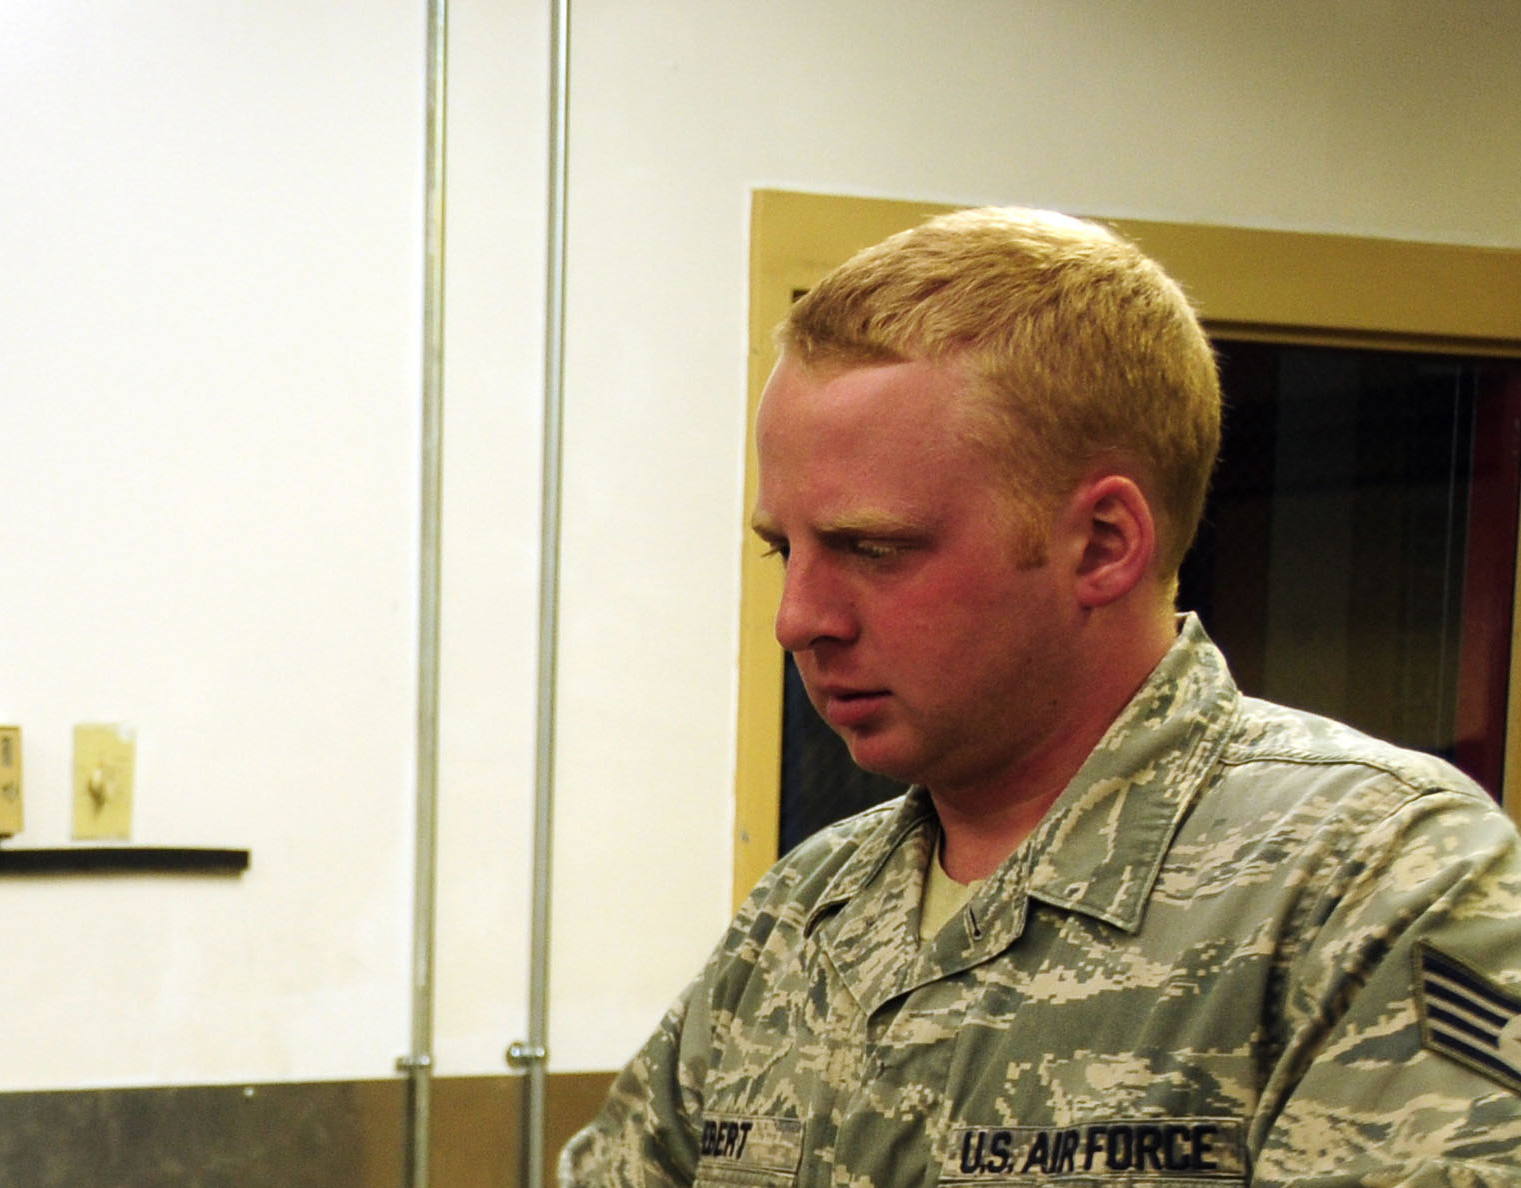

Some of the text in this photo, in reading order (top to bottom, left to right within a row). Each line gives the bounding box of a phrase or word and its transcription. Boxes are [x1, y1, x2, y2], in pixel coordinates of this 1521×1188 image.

[959, 1122, 1218, 1174] U.S. AIR FORCE
